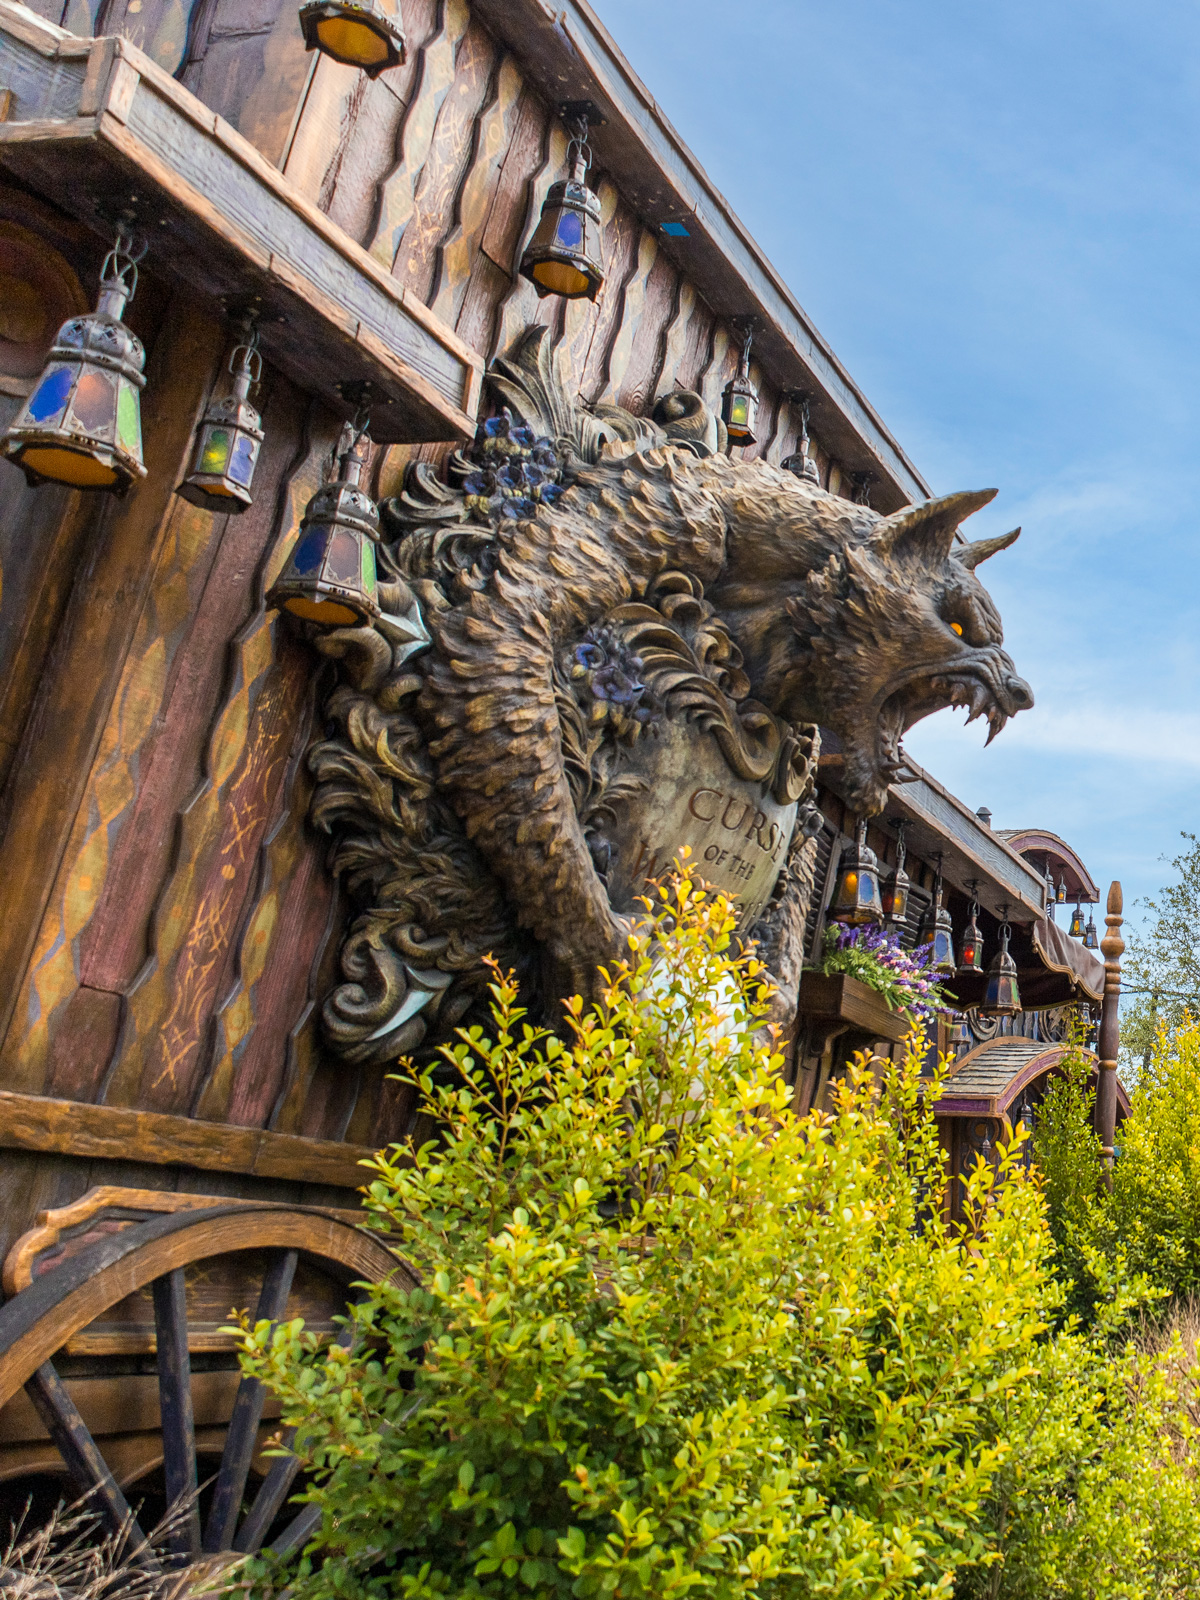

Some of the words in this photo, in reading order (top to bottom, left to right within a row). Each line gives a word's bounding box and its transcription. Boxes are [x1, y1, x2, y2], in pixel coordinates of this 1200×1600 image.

[688, 788, 786, 863] CURSE
[704, 845, 728, 866] OF
[729, 855, 756, 881] THE
